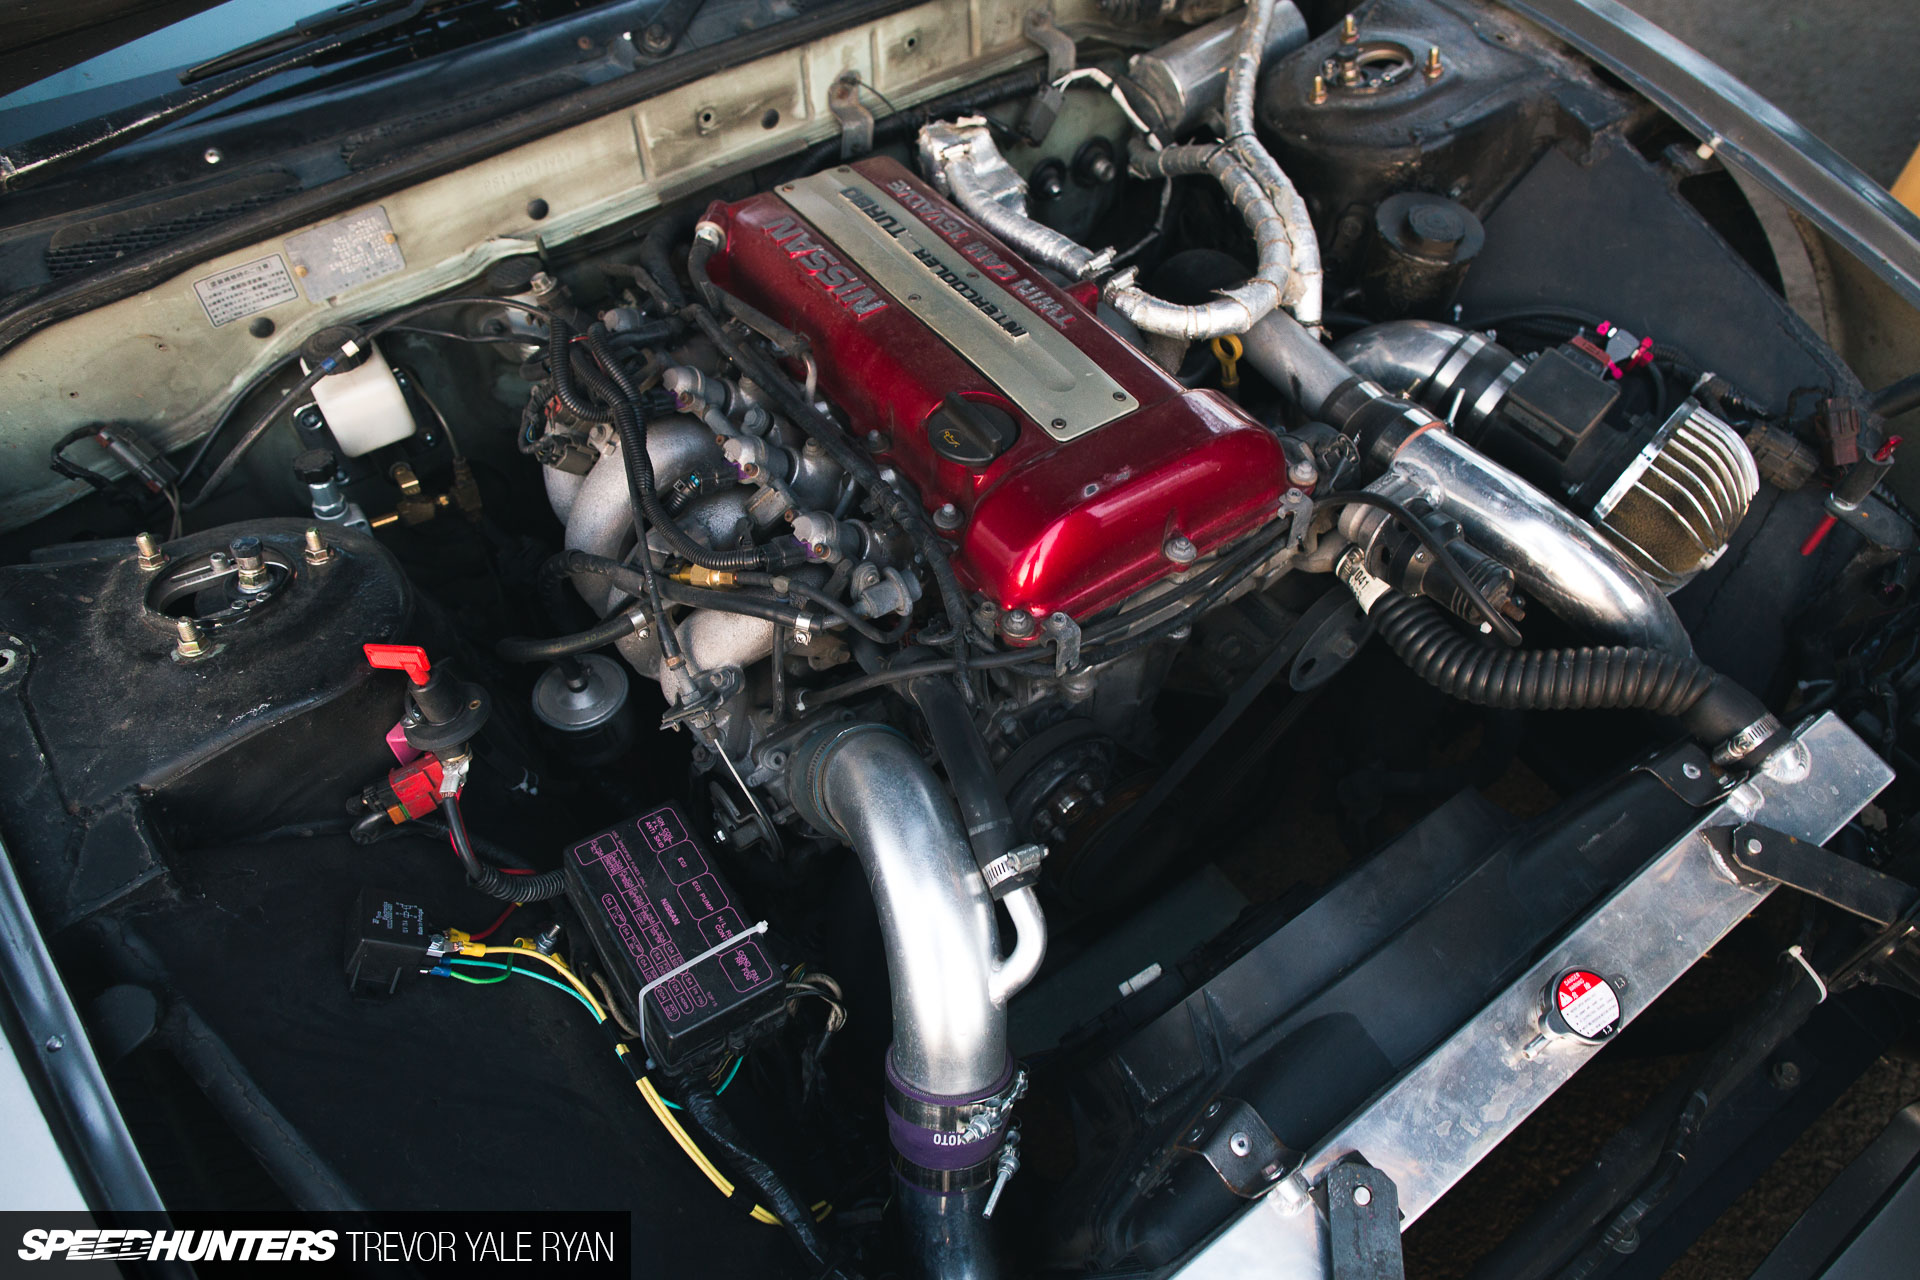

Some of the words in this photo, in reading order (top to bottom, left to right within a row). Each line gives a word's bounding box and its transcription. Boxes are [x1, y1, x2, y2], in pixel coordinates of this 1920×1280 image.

[839, 186, 909, 240] TURBO
[762, 216, 888, 321] NISSAN
[964, 241, 1019, 280] CAM
[910, 248, 1030, 341] INTERCOOLER
[1011, 278, 1076, 329] TWIN
[644, 821, 655, 834] ANTI
[653, 835, 664, 848] SKID
[656, 815, 665, 827] IGN
[677, 856, 687, 868] EGI
[661, 898, 680, 925] NISSAN
[691, 880, 701, 892] EGI
[699, 892, 713, 911] PUMP
